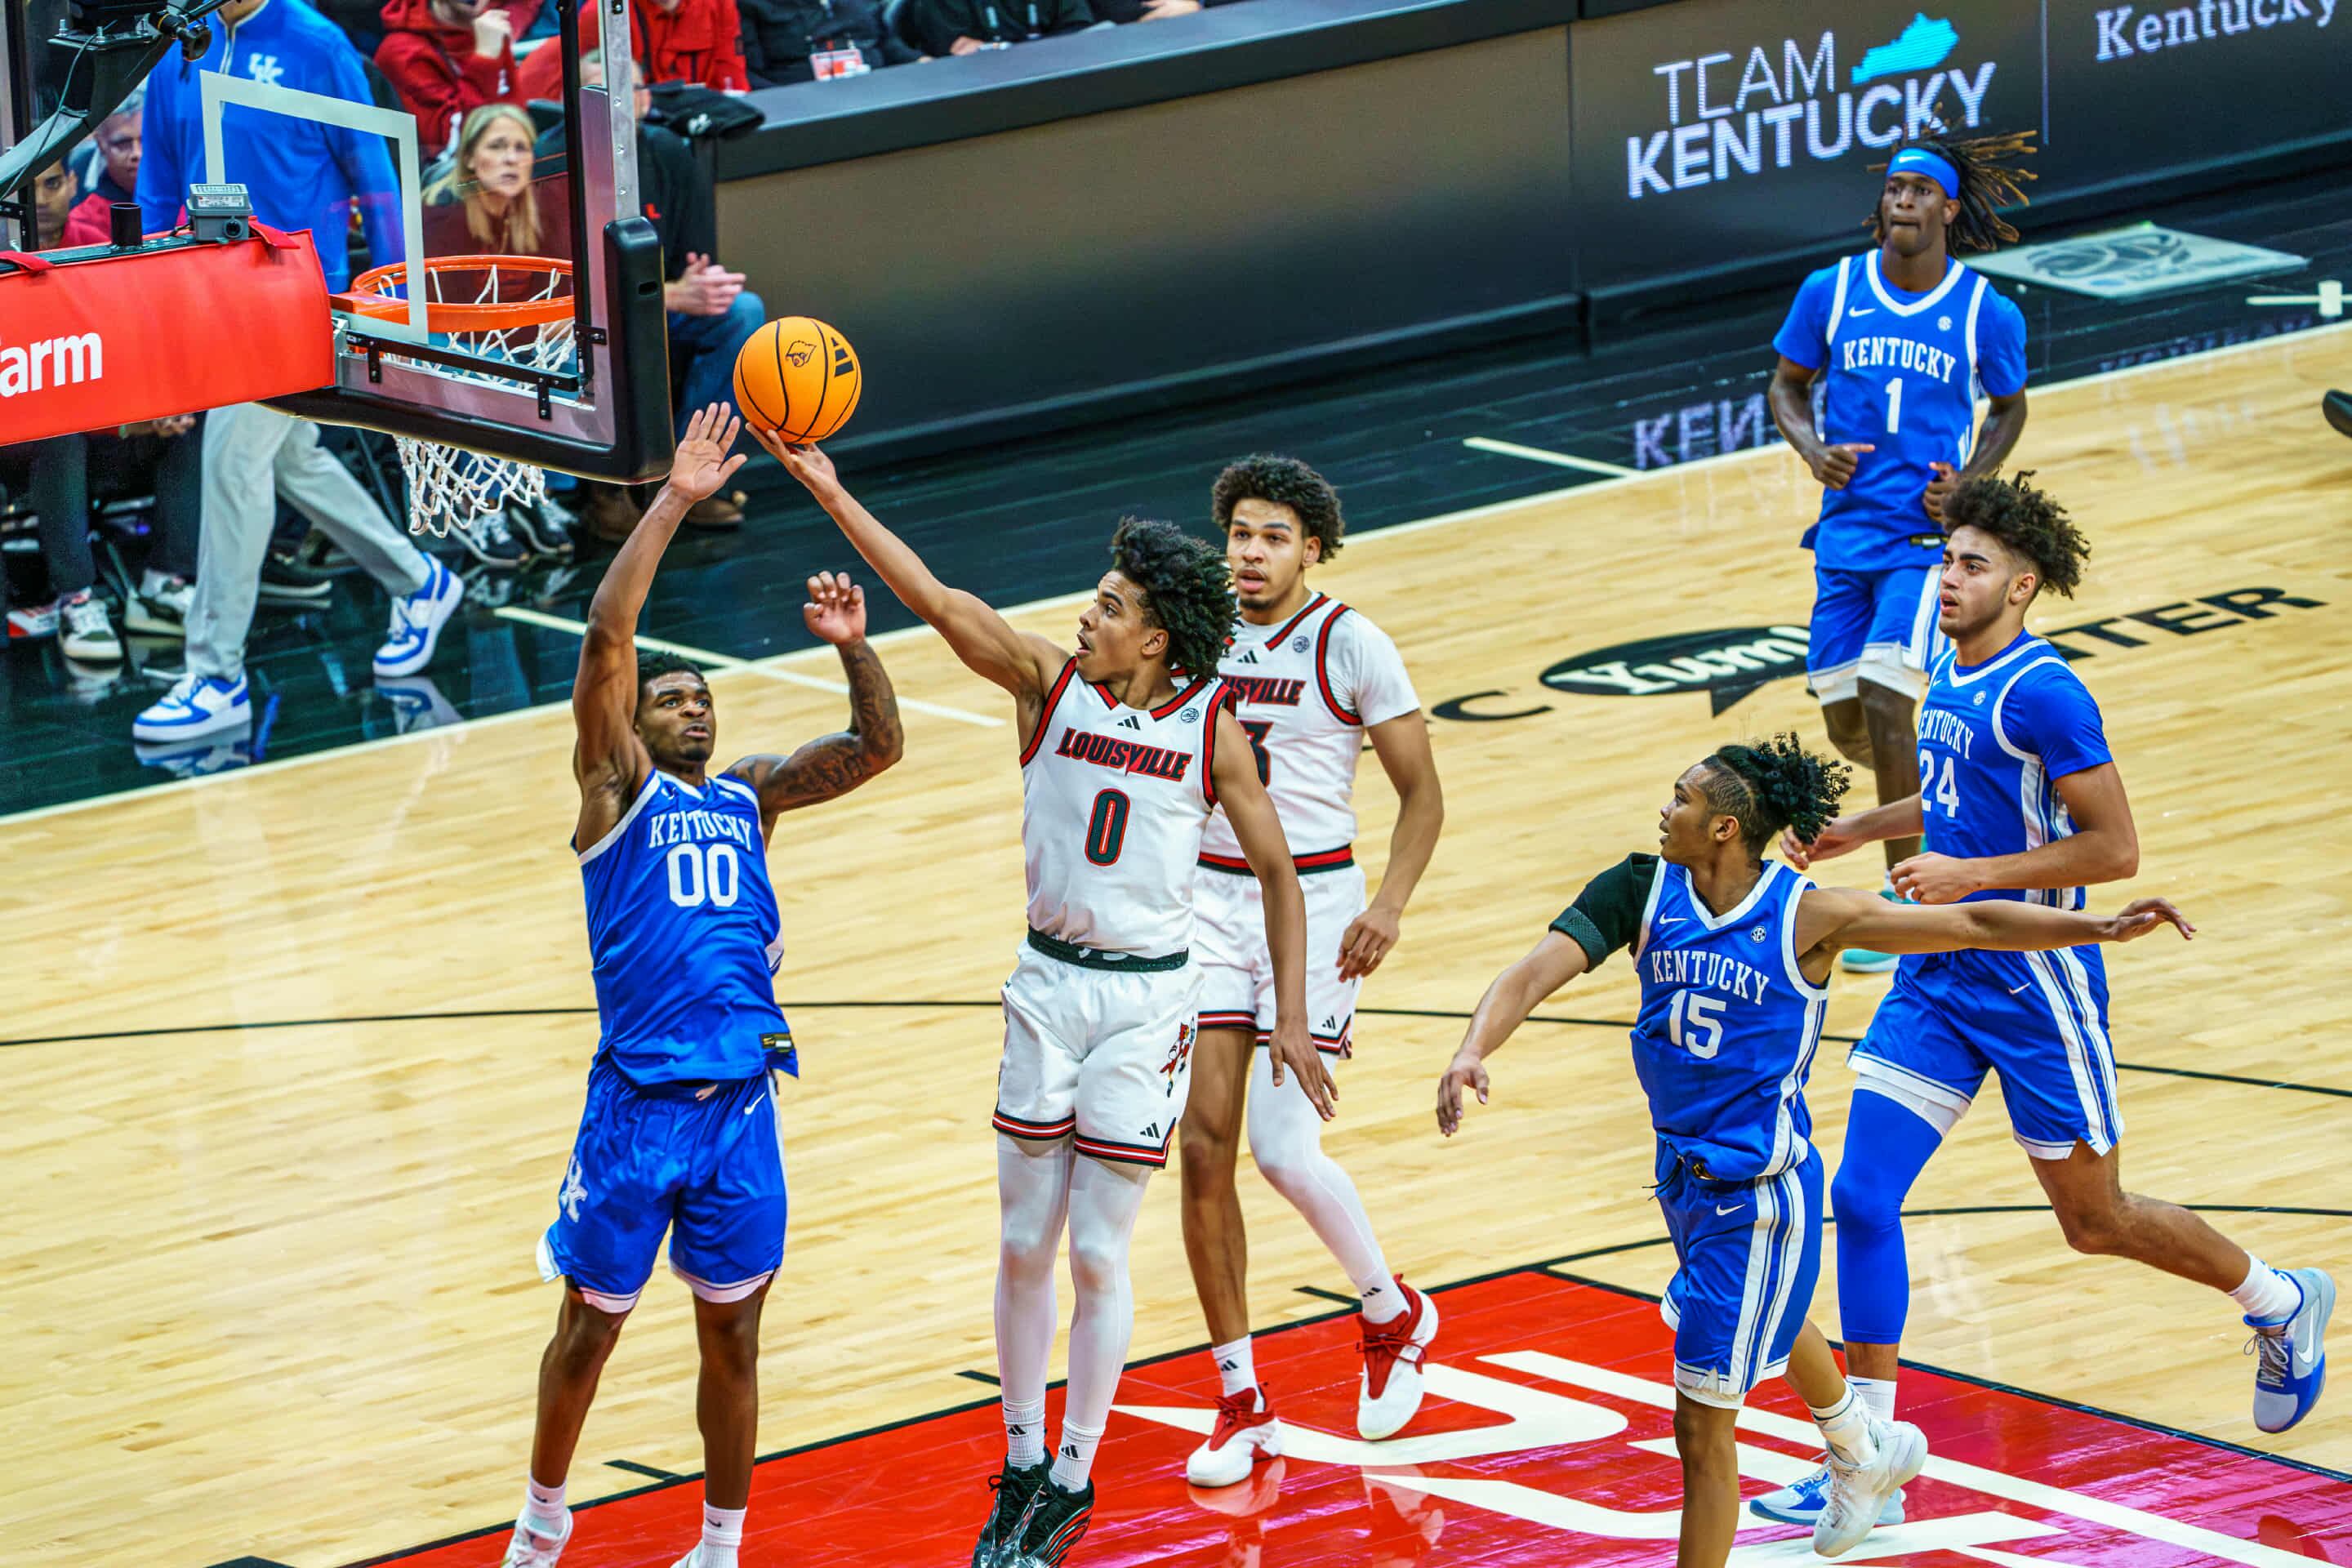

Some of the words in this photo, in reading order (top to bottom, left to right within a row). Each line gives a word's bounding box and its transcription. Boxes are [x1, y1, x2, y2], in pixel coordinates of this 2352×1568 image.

[1653, 30, 1837, 125] TEAM
[1626, 60, 1998, 199] KENTUCKY
[0, 332, 103, 399] arm
[1842, 336, 1957, 384] KENTUCKY
[1885, 376, 1904, 434] 1
[2041, 587, 2331, 661] TER
[1055, 727, 1194, 782] LOUISVILLE
[1918, 709, 1974, 760] ENTUCKY
[1920, 749, 1960, 818] 24
[1085, 787, 1131, 866] 0
[666, 843, 739, 907] 00
[1651, 949, 1770, 1005] KENTUCKY
[1669, 989, 1727, 1060] 15
